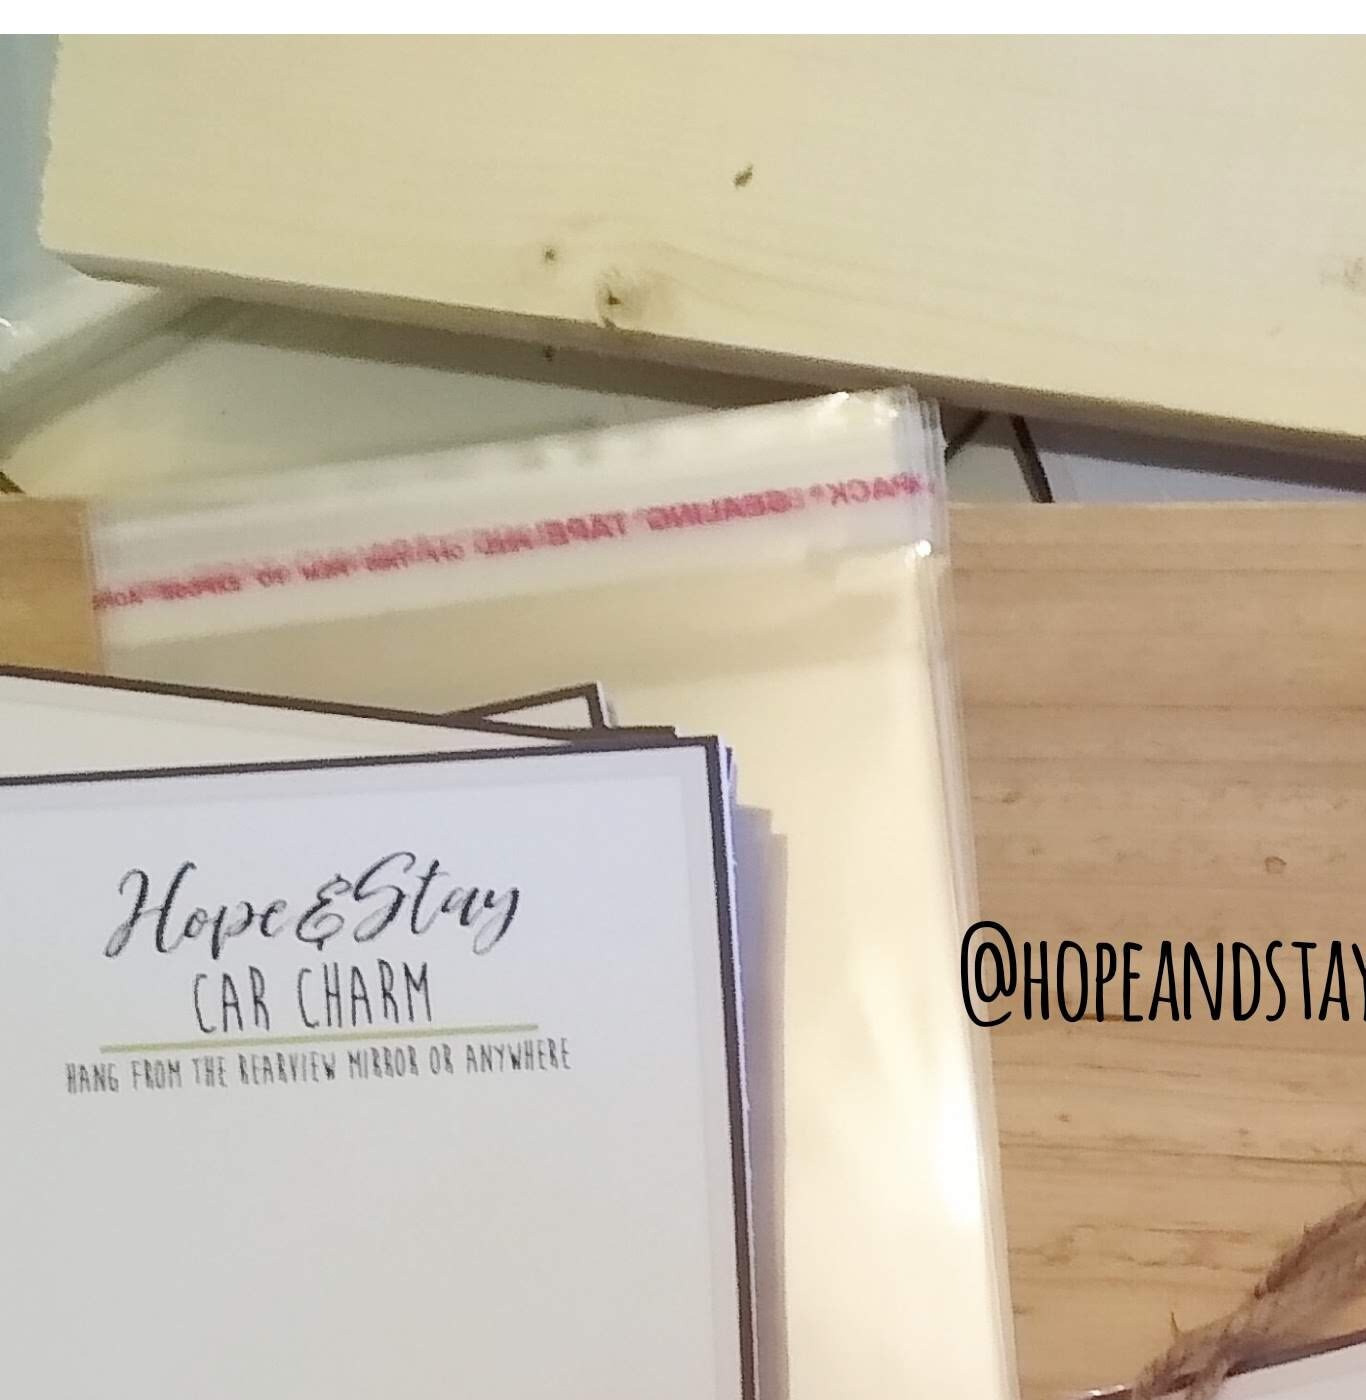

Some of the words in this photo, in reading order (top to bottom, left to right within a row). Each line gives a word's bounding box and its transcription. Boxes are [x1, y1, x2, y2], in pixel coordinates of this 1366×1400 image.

[194, 966, 270, 1033] CAR
[298, 959, 432, 1029] CHARM
[64, 1061, 119, 1094] HANG
[131, 1058, 182, 1091] FROM
[193, 1054, 228, 1088] THE
[239, 1050, 337, 1084] REARVIEW
[348, 1045, 418, 1080] MIRROR
[429, 1043, 454, 1076] OR
[465, 1037, 572, 1073] ANYWHERE
